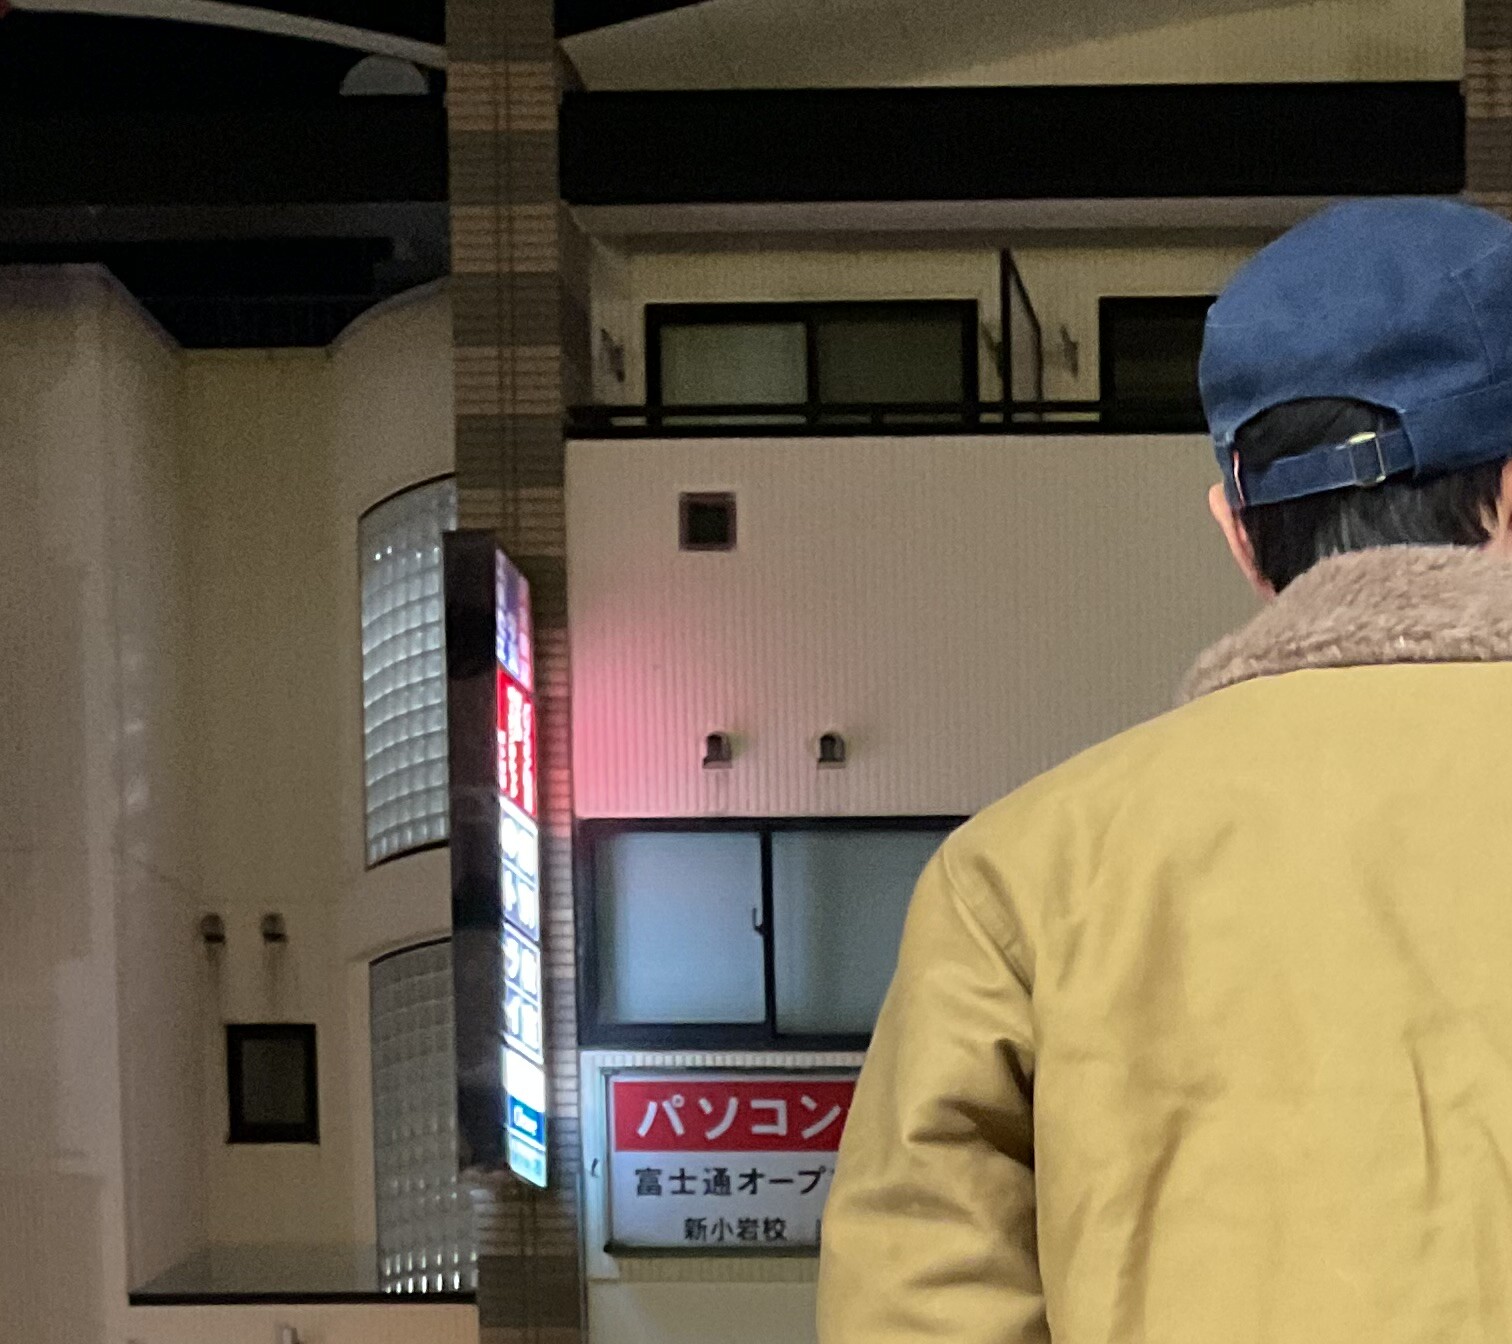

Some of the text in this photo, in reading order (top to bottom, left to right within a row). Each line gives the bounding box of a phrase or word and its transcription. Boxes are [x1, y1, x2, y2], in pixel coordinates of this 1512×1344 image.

[637, 1094, 841, 1139] パソコン
[635, 1165, 834, 1196] 富士通オープ
[684, 1217, 787, 1241] 新小岩校
